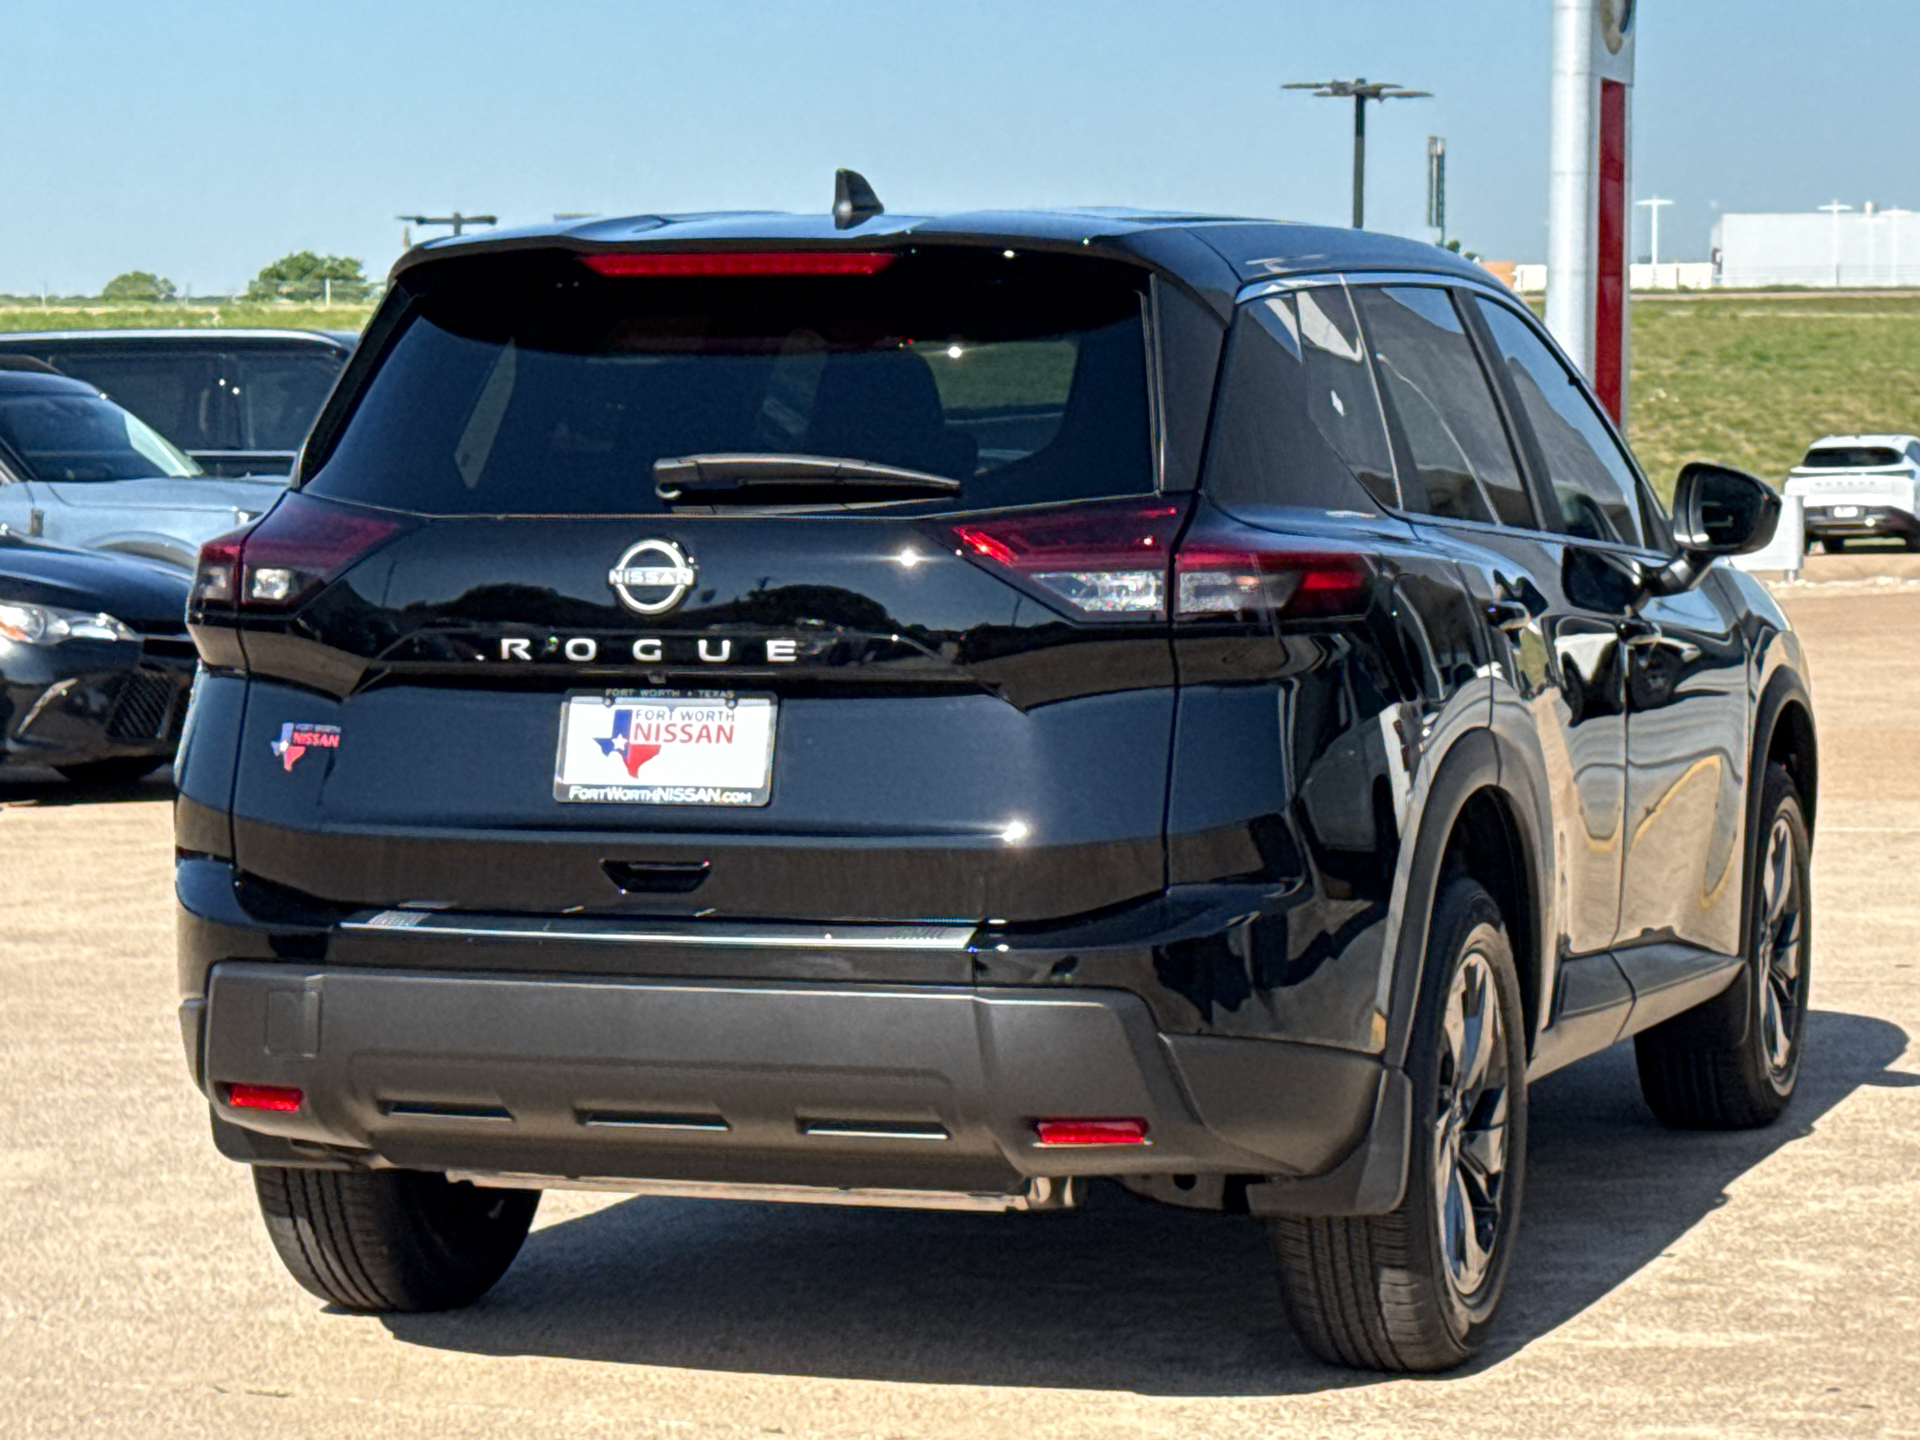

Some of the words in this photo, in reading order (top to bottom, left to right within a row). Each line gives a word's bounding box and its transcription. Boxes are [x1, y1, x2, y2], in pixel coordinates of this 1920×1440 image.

[609, 569, 693, 585] NISSAN
[500, 638, 797, 662] ROGUE
[605, 688, 634, 697] FORT
[640, 689, 680, 697] WORTH
[698, 690, 735, 698] TEXAS
[636, 709, 676, 721] FORT
[680, 710, 735, 722] WORTH
[293, 731, 339, 748] NISSAN
[634, 723, 734, 744] NISSAN
